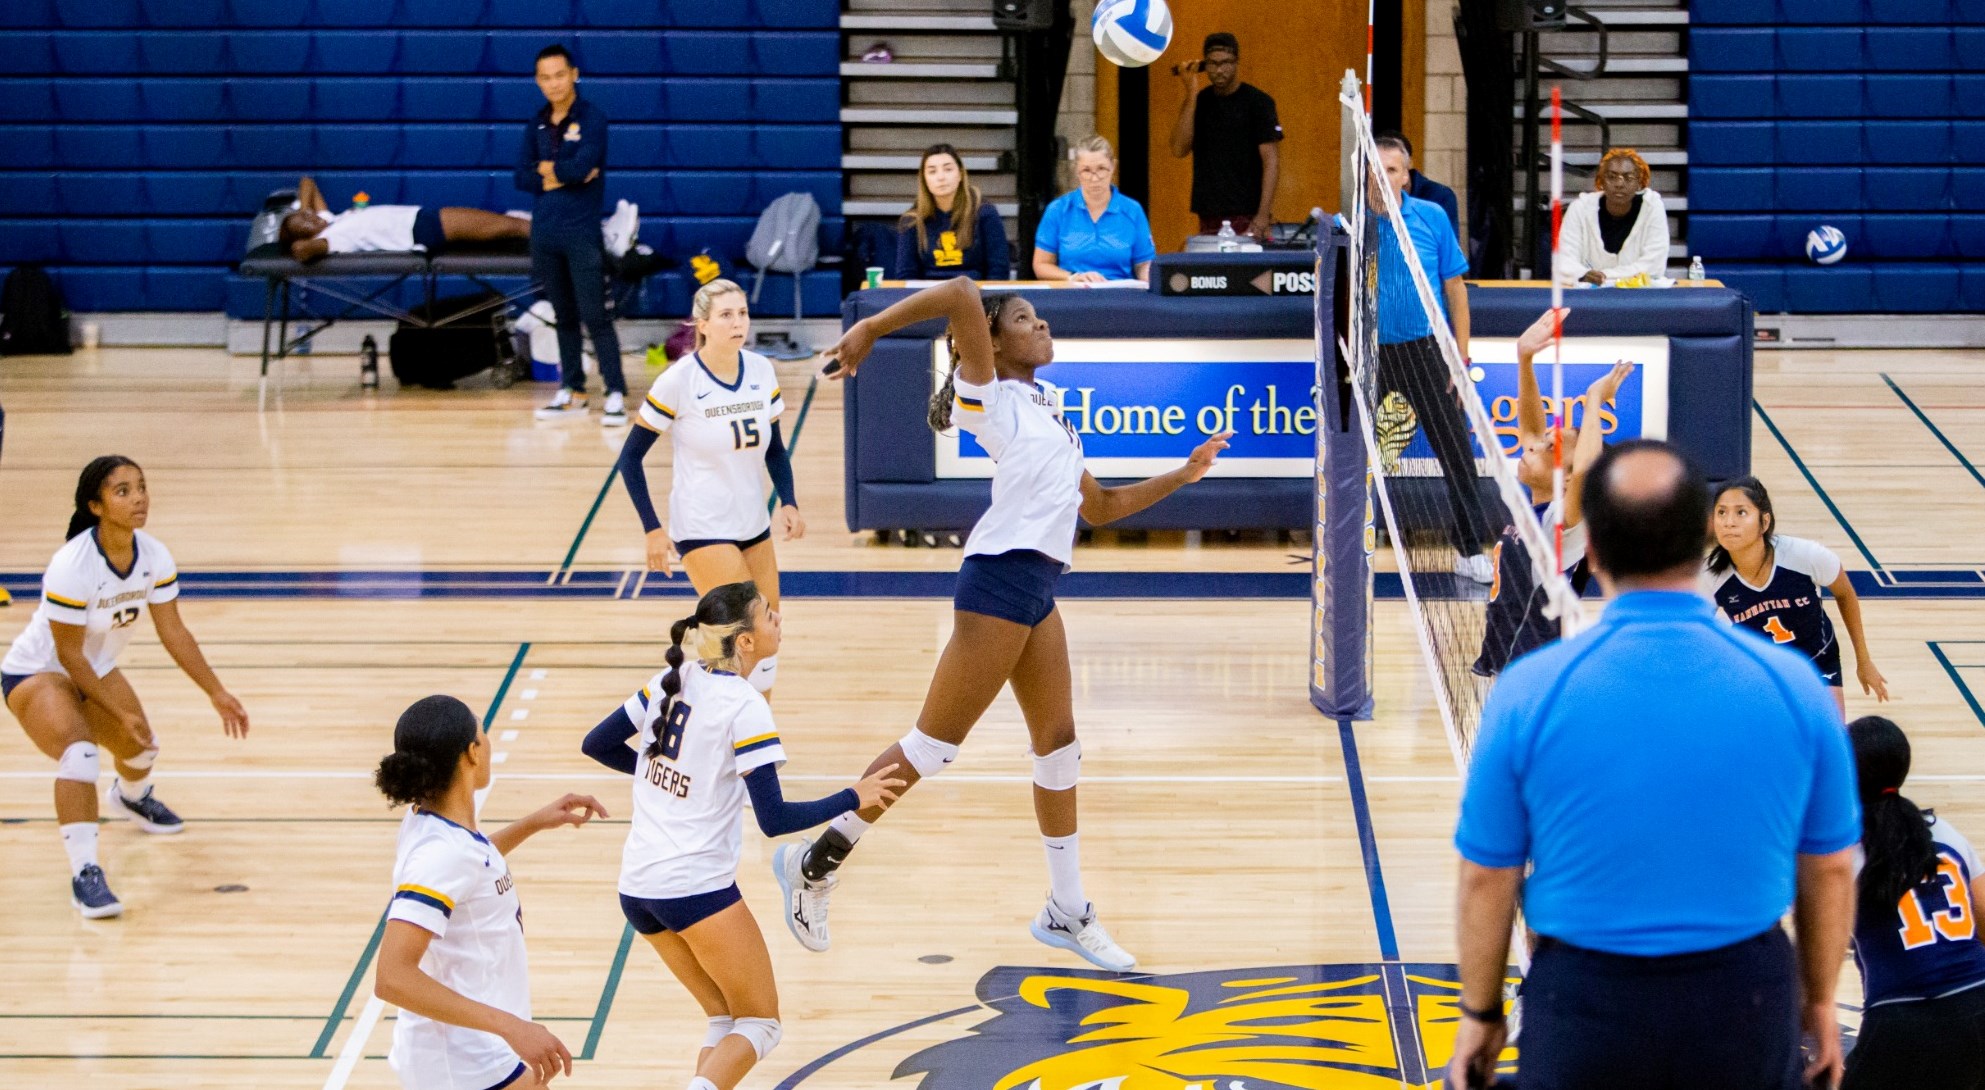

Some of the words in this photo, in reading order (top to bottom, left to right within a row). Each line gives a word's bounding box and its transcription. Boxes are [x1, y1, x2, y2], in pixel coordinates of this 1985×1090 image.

[1190, 276, 1228, 289] BONUS
[1054, 387, 1186, 435] Home
[1196, 384, 1246, 435] of
[1249, 384, 1316, 435] the
[730, 417, 760, 450] 15
[1762, 615, 1796, 644] 1
[1897, 851, 1976, 951] 13
